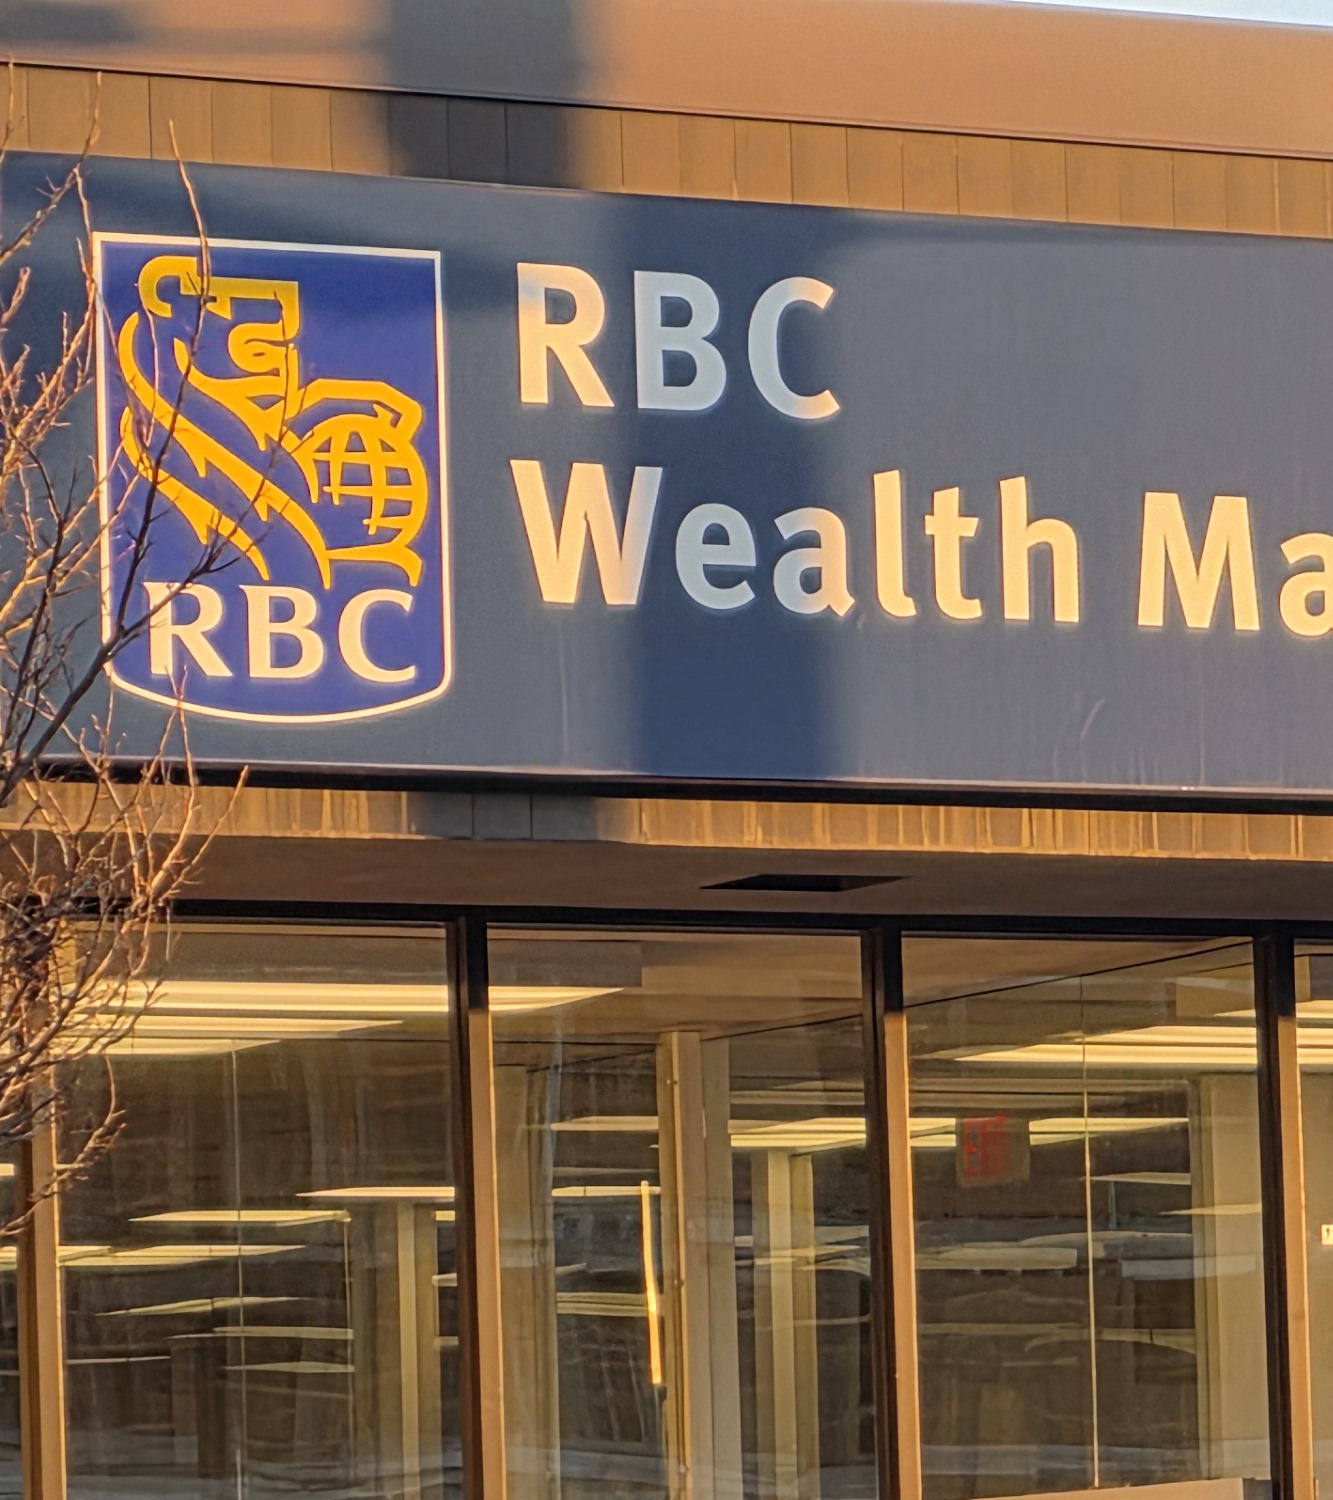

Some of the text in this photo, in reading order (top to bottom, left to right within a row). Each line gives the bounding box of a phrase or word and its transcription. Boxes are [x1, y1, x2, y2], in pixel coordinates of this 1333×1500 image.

[514, 262, 841, 421] RBC
[510, 457, 1080, 624] Wealth
[142, 579, 418, 684] RBC
